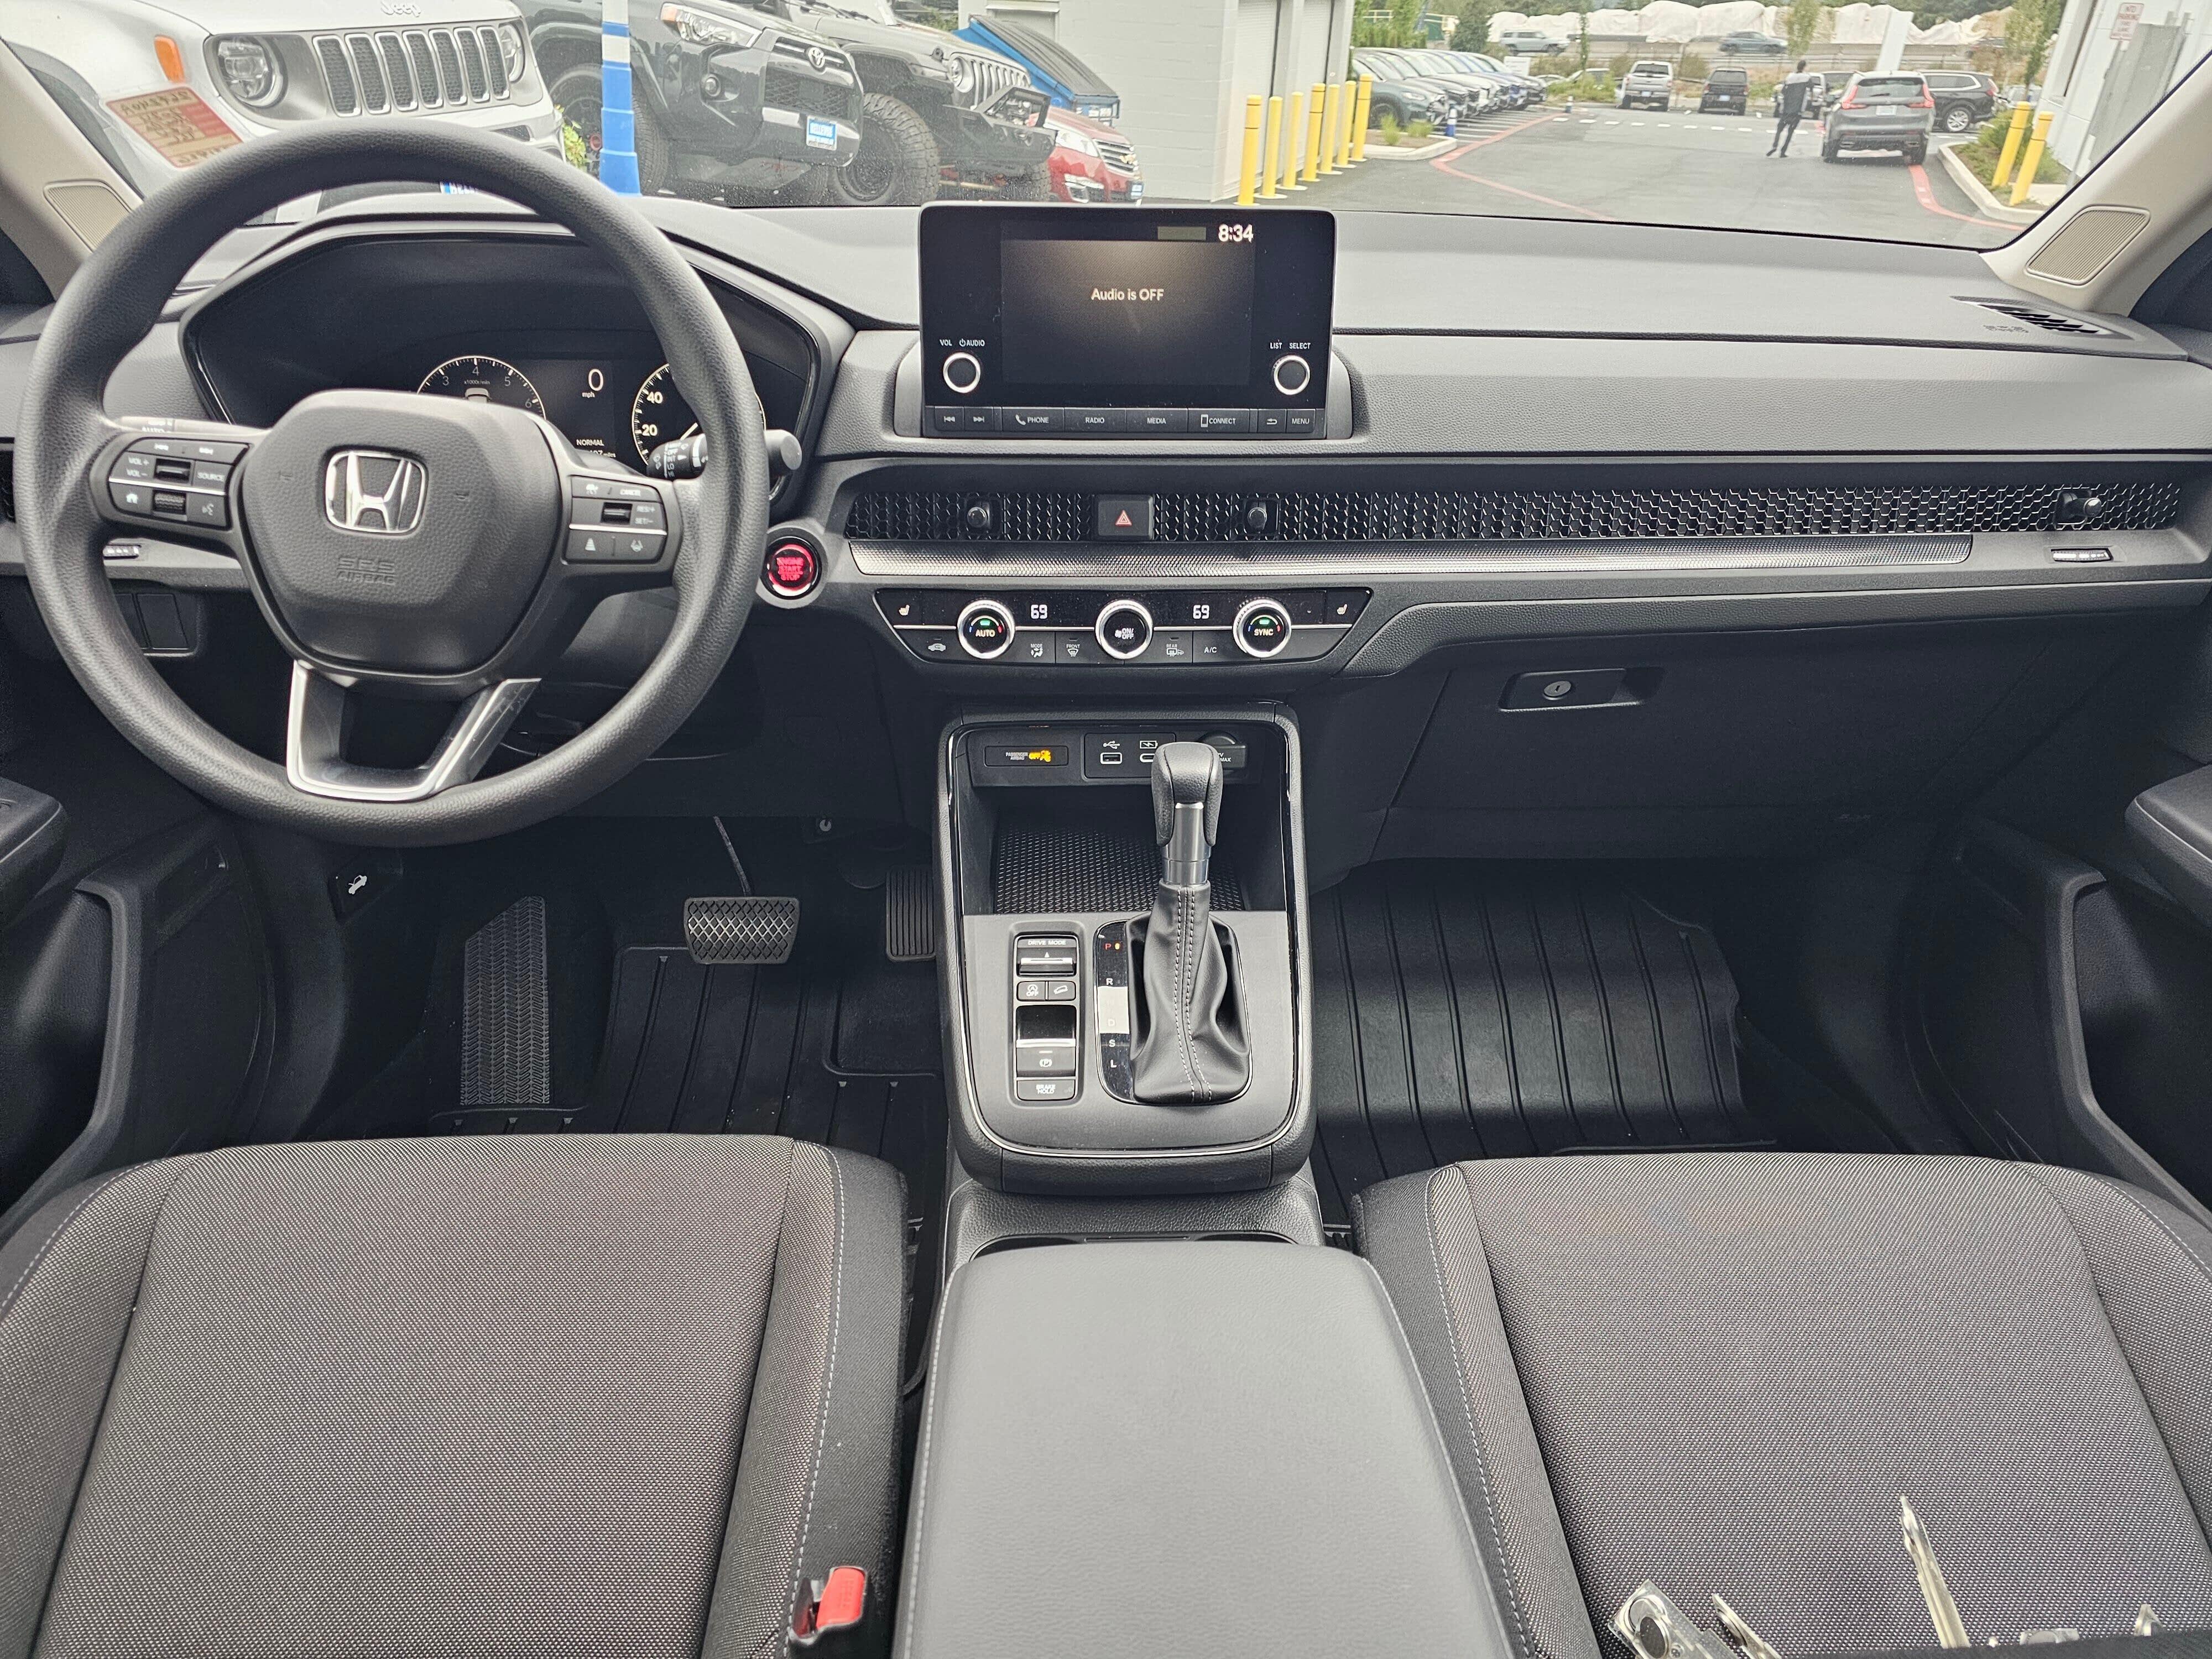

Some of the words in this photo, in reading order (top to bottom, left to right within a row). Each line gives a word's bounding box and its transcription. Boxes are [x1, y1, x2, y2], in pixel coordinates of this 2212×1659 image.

[380, 0, 422, 18] Jeep
[1218, 223, 1254, 243] 8:34
[1091, 288, 1125, 300] Audio
[1127, 288, 1137, 300] is
[1139, 288, 1165, 301] OFF
[472, 366, 479, 376] 4
[442, 375, 450, 386] 3
[504, 376, 511, 387] 5
[588, 368, 604, 391] 0
[525, 398, 532, 408] 6
[646, 392, 663, 404] 40
[641, 424, 658, 436] 20
[197, 472, 226, 482] SOURCE
[1030, 604, 1048, 619] 69
[1192, 604, 1210, 619] 69
